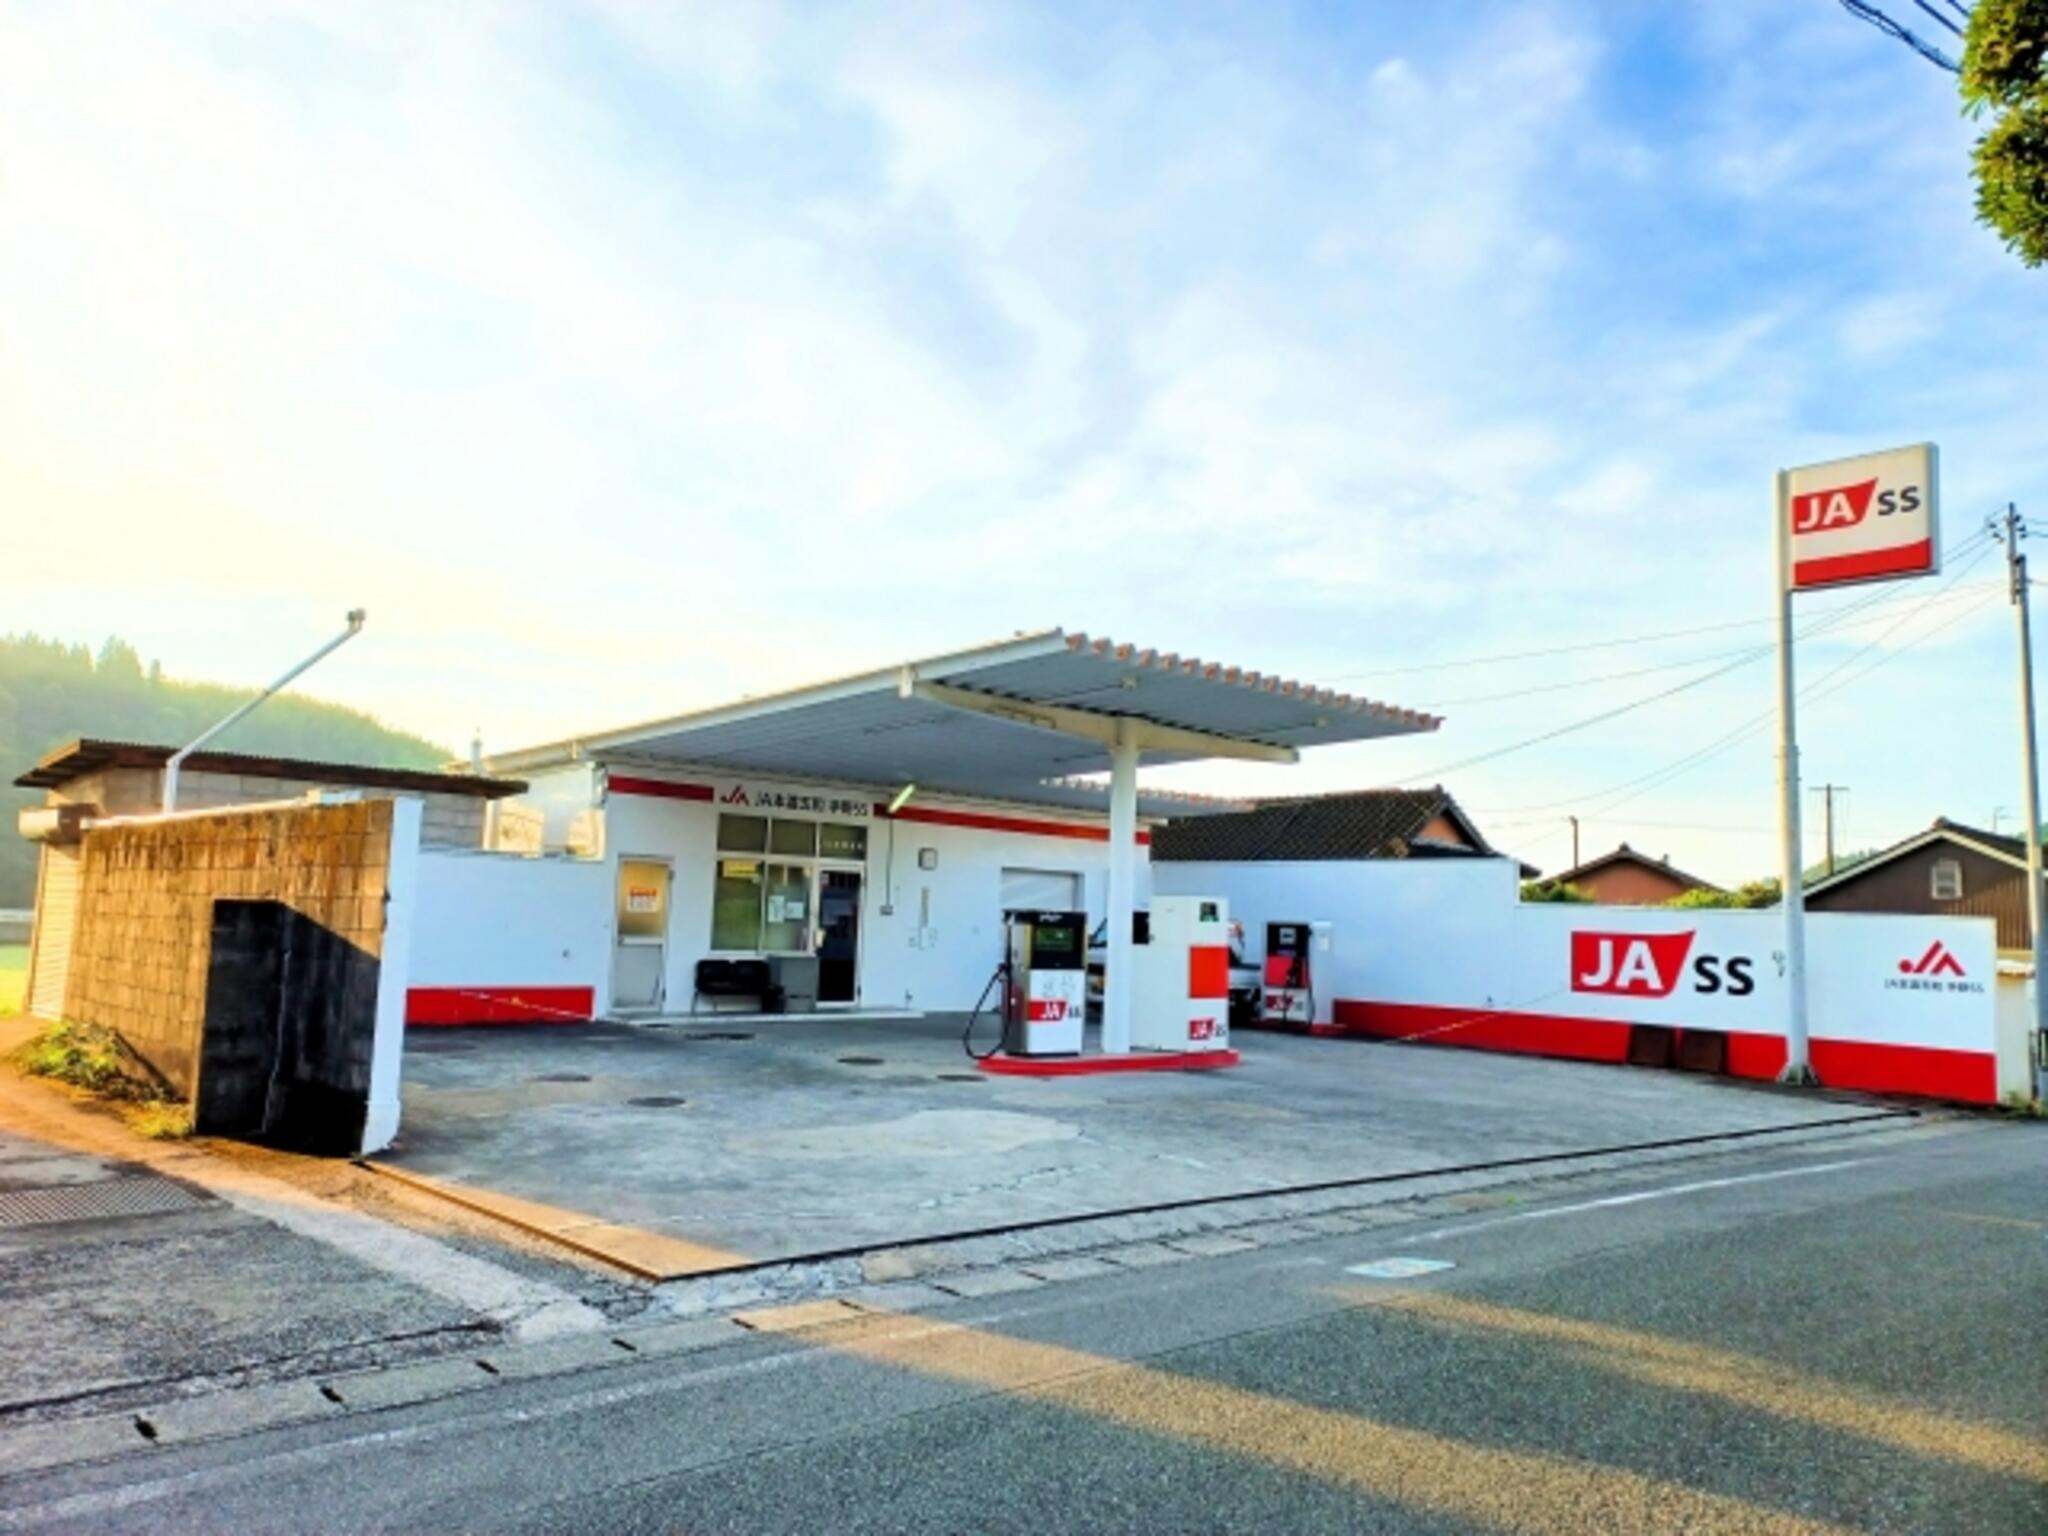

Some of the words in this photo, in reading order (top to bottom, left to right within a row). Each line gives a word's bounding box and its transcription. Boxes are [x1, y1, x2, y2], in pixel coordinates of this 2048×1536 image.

[1797, 491, 1856, 529] JA
[1877, 486, 1921, 516] SS
[1580, 939, 1664, 990] JA
[1694, 955, 1755, 996] SS
